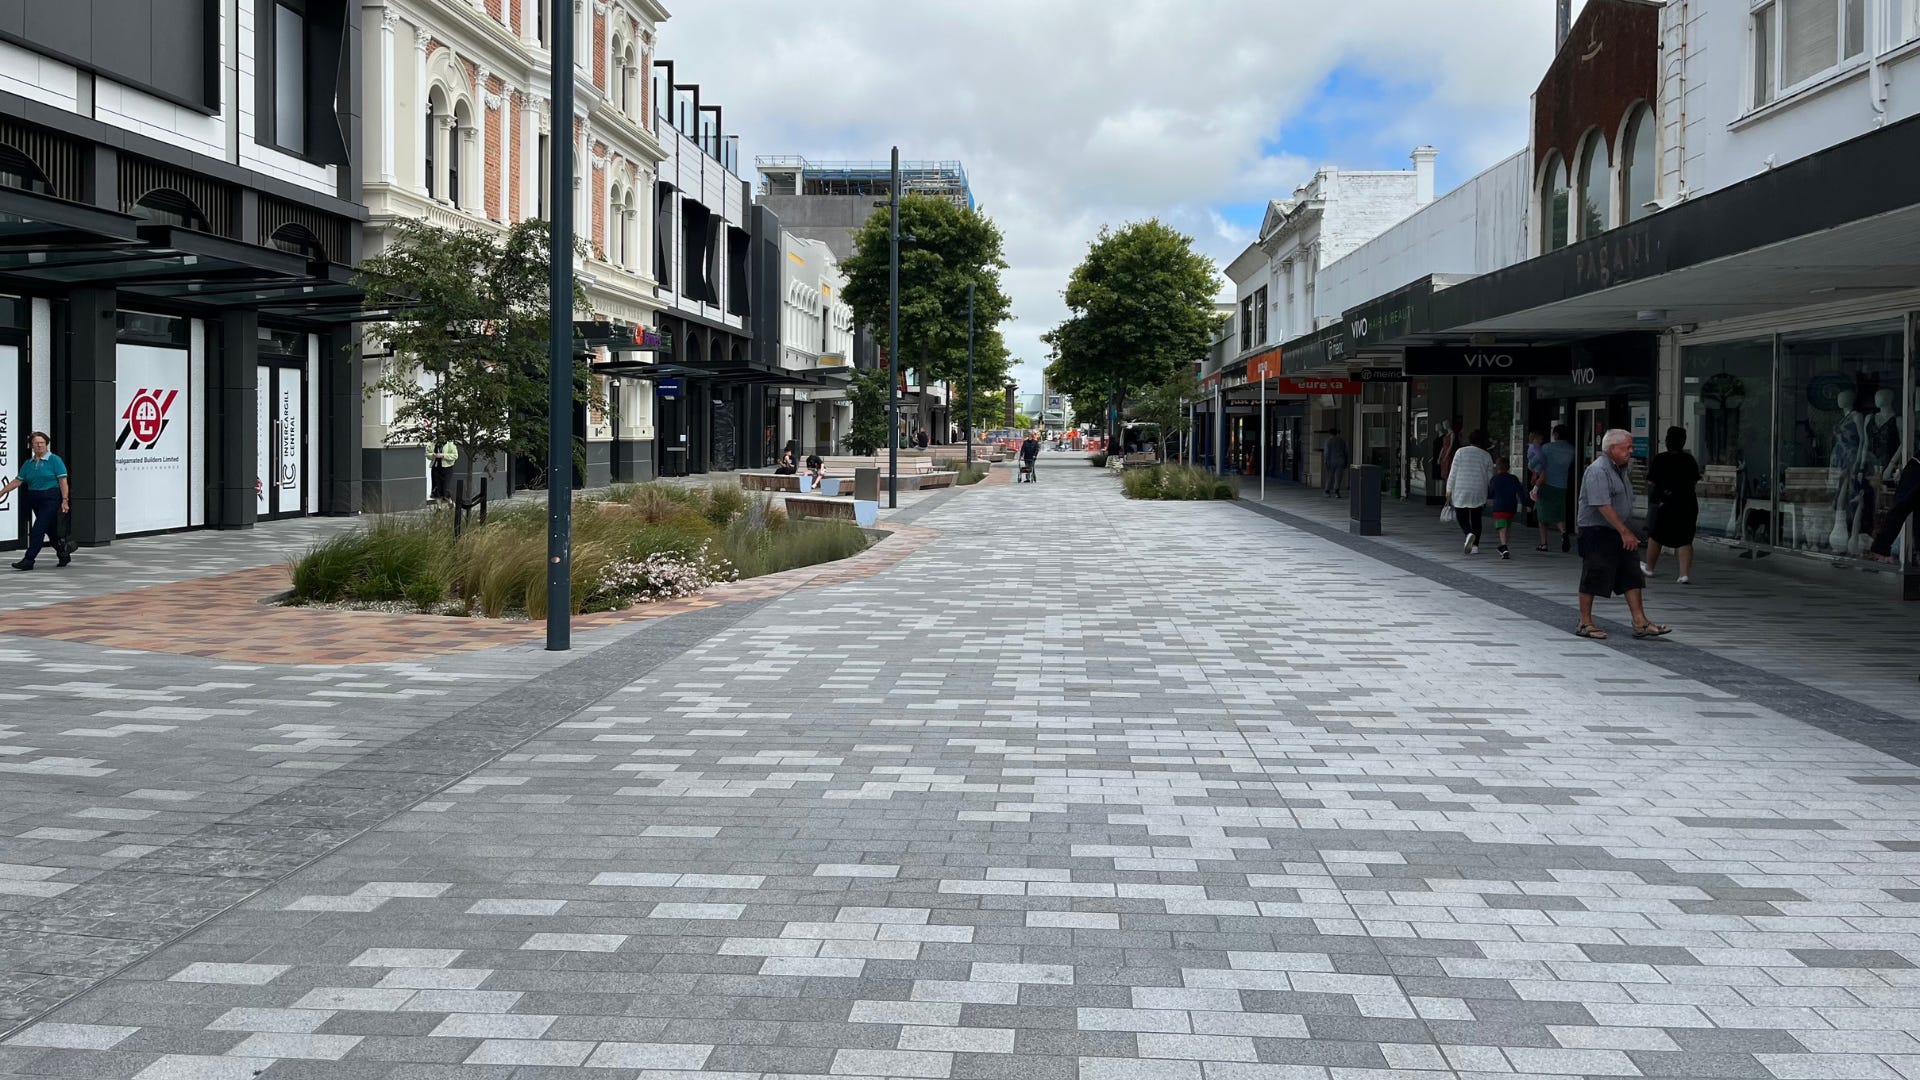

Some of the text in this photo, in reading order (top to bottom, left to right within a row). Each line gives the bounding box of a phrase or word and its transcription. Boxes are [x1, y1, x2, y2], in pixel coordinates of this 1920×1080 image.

[1351, 317, 1367, 339] VIVO
[1572, 369, 1595, 385] VIVO
[116, 457, 143, 465] malgamated
